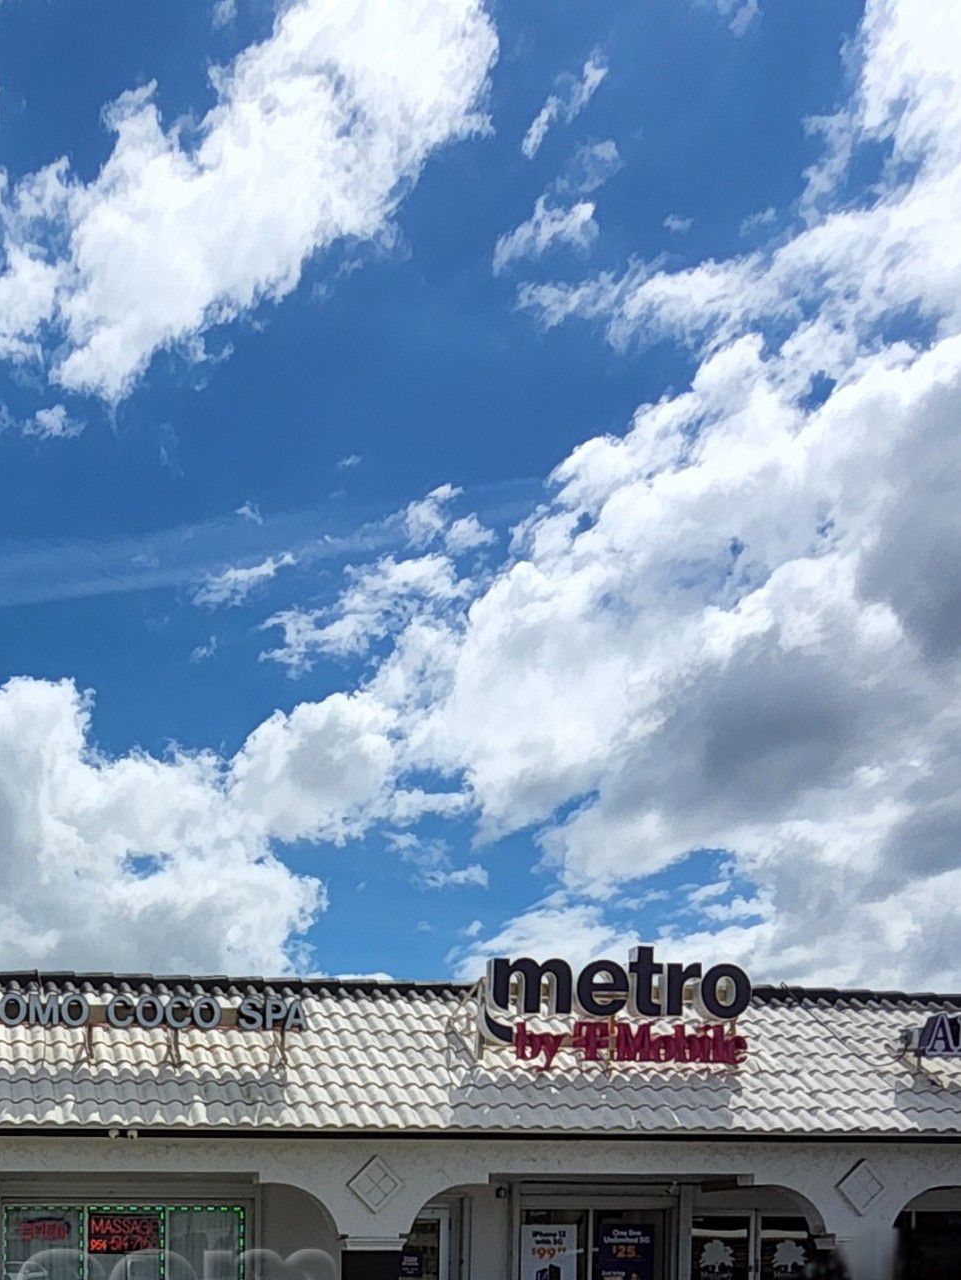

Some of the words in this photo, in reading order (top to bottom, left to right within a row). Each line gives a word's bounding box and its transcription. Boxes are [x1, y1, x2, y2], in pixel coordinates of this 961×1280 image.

[485, 946, 752, 1042] metro
[107, 995, 221, 1029] COCO
[238, 997, 309, 1031] SPA
[515, 1022, 564, 1071] by
[20, 1221, 68, 1242] OPEN
[90, 1218, 160, 1235] MASSAGE
[532, 1230, 557, 1238] iPhone
